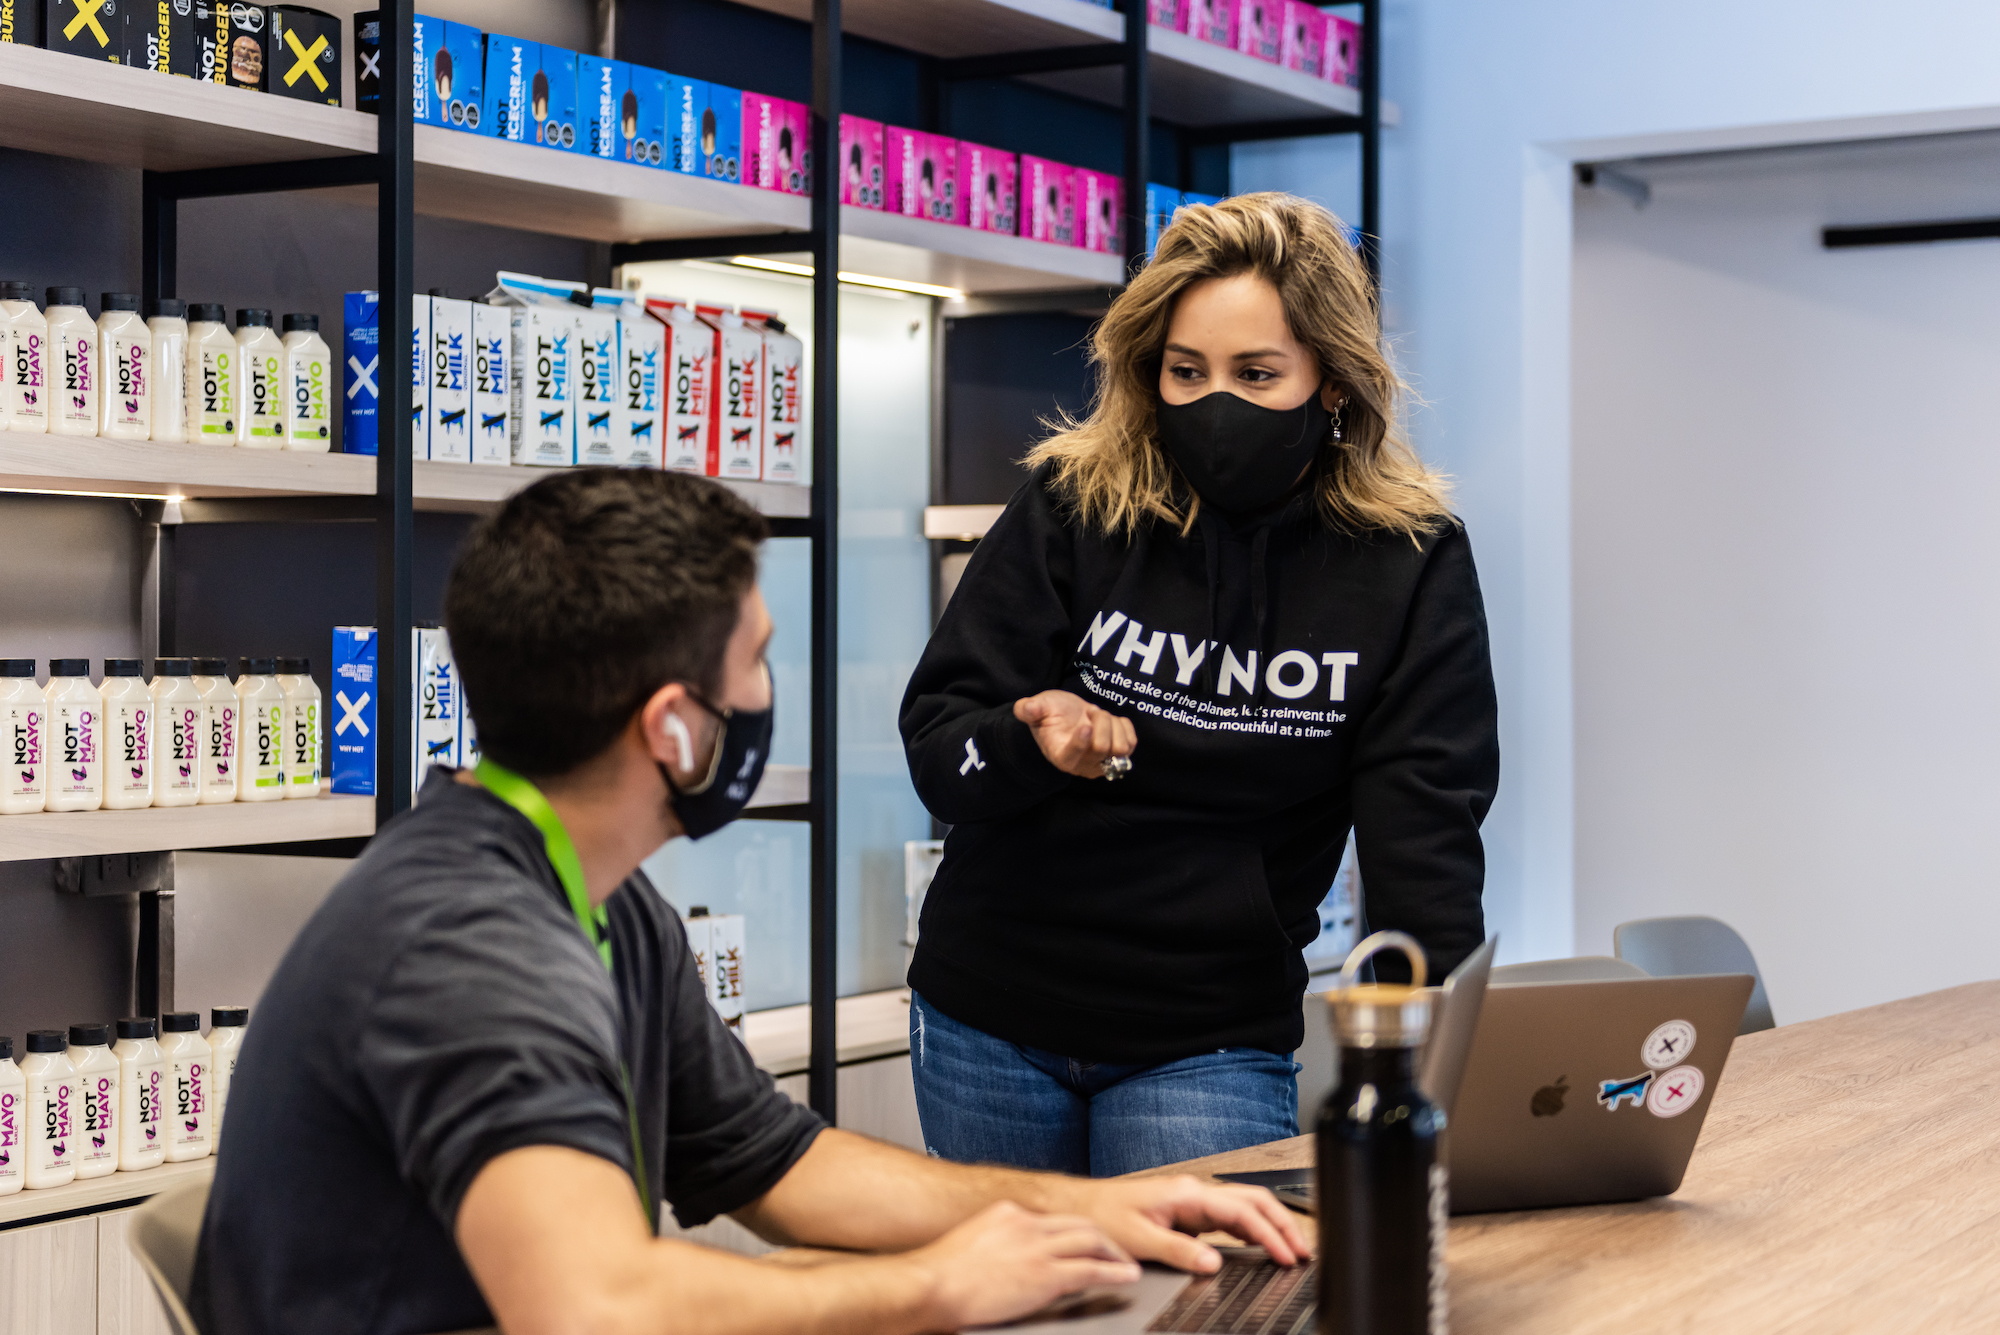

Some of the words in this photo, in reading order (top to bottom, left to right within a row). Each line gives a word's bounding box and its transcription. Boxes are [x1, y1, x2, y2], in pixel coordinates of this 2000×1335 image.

[147, 32, 159, 73] NOT
[158, 1, 170, 75] BURGER
[202, 36, 216, 84] NOT
[214, 2, 230, 86] BURGER
[497, 99, 508, 138] NOT
[507, 46, 523, 140] ICECREAM
[599, 66, 613, 158] ICECREAM
[590, 117, 600, 154] NOT
[673, 135, 681, 170] NOT
[17, 345, 28, 386] NOT
[29, 334, 40, 387] MAYO
[66, 350, 77, 390] NOT
[78, 340, 88, 391] MAYO
[119, 355, 130, 395] NOT
[131, 345, 142, 396] MAYO
[217, 353, 230, 413] MAYO
[266, 357, 279, 416] MAYO
[436, 332, 448, 389] NOT
[449, 332, 462, 391] MILK
[476, 337, 489, 393] NOT
[489, 337, 503, 394] MILK
[537, 335, 551, 399] NOT
[552, 335, 567, 401] MILK
[581, 338, 596, 400] NOT
[597, 338, 611, 402] MILK
[628, 348, 642, 410] NOT
[643, 347, 656, 412] MILK
[676, 354, 691, 415] NOT
[690, 354, 705, 416] MILK
[204, 367, 217, 412] NOT
[253, 371, 266, 415] NOT
[296, 375, 310, 419] NOT
[310, 361, 323, 419] MAYO
[729, 358, 742, 417] NOT
[742, 357, 755, 418] MILK
[772, 364, 784, 422] NOT
[784, 364, 798, 423] MILK
[1077, 610, 1216, 686] WHY
[1217, 644, 1359, 702] NOT
[423, 665, 437, 720] NOT
[437, 662, 451, 719] MILK
[1111, 671, 1132, 688] the
[1132, 681, 1162, 698] sake
[1163, 692, 1179, 702] of
[1178, 695, 1197, 709] the
[1197, 701, 1239, 717] planet,
[1270, 707, 1324, 722] reinvent
[1326, 710, 1347, 722] the
[14, 724, 27, 765] NOT
[27, 711, 39, 765] MAYO
[64, 722, 78, 763] NOT
[78, 711, 92, 763] MAYO
[124, 722, 135, 761] NOT
[135, 709, 146, 761] MAYO
[173, 721, 184, 760] NOT
[184, 709, 195, 759] MAYO
[211, 719, 222, 757] NOT
[222, 708, 233, 758] MAYO
[258, 721, 270, 766] NOT
[270, 706, 281, 765] MAYO
[296, 720, 306, 764] NOT
[307, 705, 317, 763] MAYO
[1137, 701, 1162, 716] one
[1162, 706, 1217, 730] delicious
[1219, 720, 1278, 735] mouthful
[1279, 725, 1293, 736] at
[1294, 728, 1302, 737] a
[716, 950, 727, 999] NOT
[727, 945, 740, 998] MILK
[58, 1085, 69, 1138] MAYO
[85, 1091, 97, 1131] NOT
[98, 1078, 109, 1130] MAYO
[139, 1085, 150, 1123] NOT
[150, 1071, 159, 1122] MAYO
[178, 1077, 190, 1115] NOT
[190, 1064, 201, 1114] MAYO
[1, 1093, 14, 1147] MAYO
[46, 1099, 57, 1140] NOT
